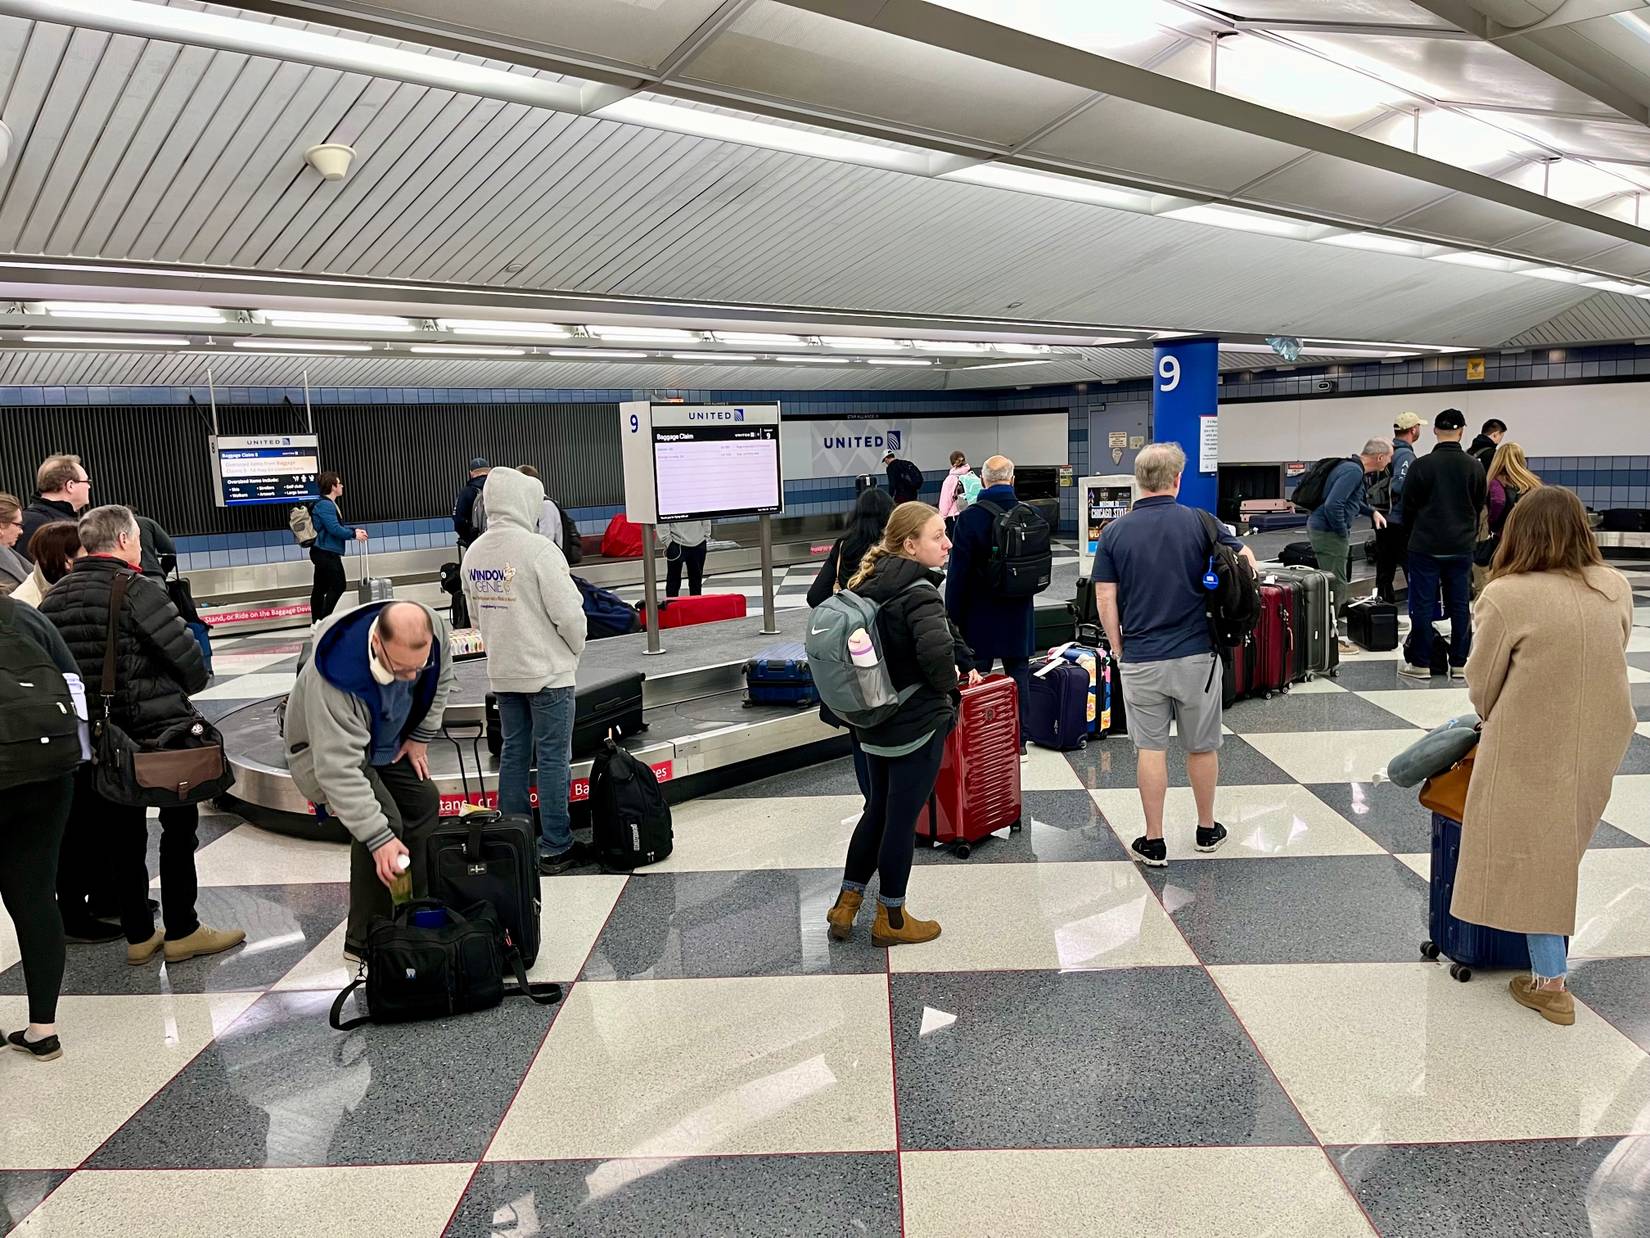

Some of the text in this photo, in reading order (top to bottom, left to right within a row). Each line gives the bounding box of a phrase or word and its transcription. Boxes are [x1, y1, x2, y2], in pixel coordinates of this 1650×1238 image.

[1159, 355, 1180, 392] 9
[688, 412, 732, 420] UNITED
[629, 414, 639, 433] 9
[656, 433, 679, 441] Baggage
[766, 432, 771, 440] 9
[823, 436, 884, 449] UNITED
[1091, 508, 1112, 519] CHICAGO
[475, 581, 504, 593] GENIE
[271, 607, 296, 616] Baggage
